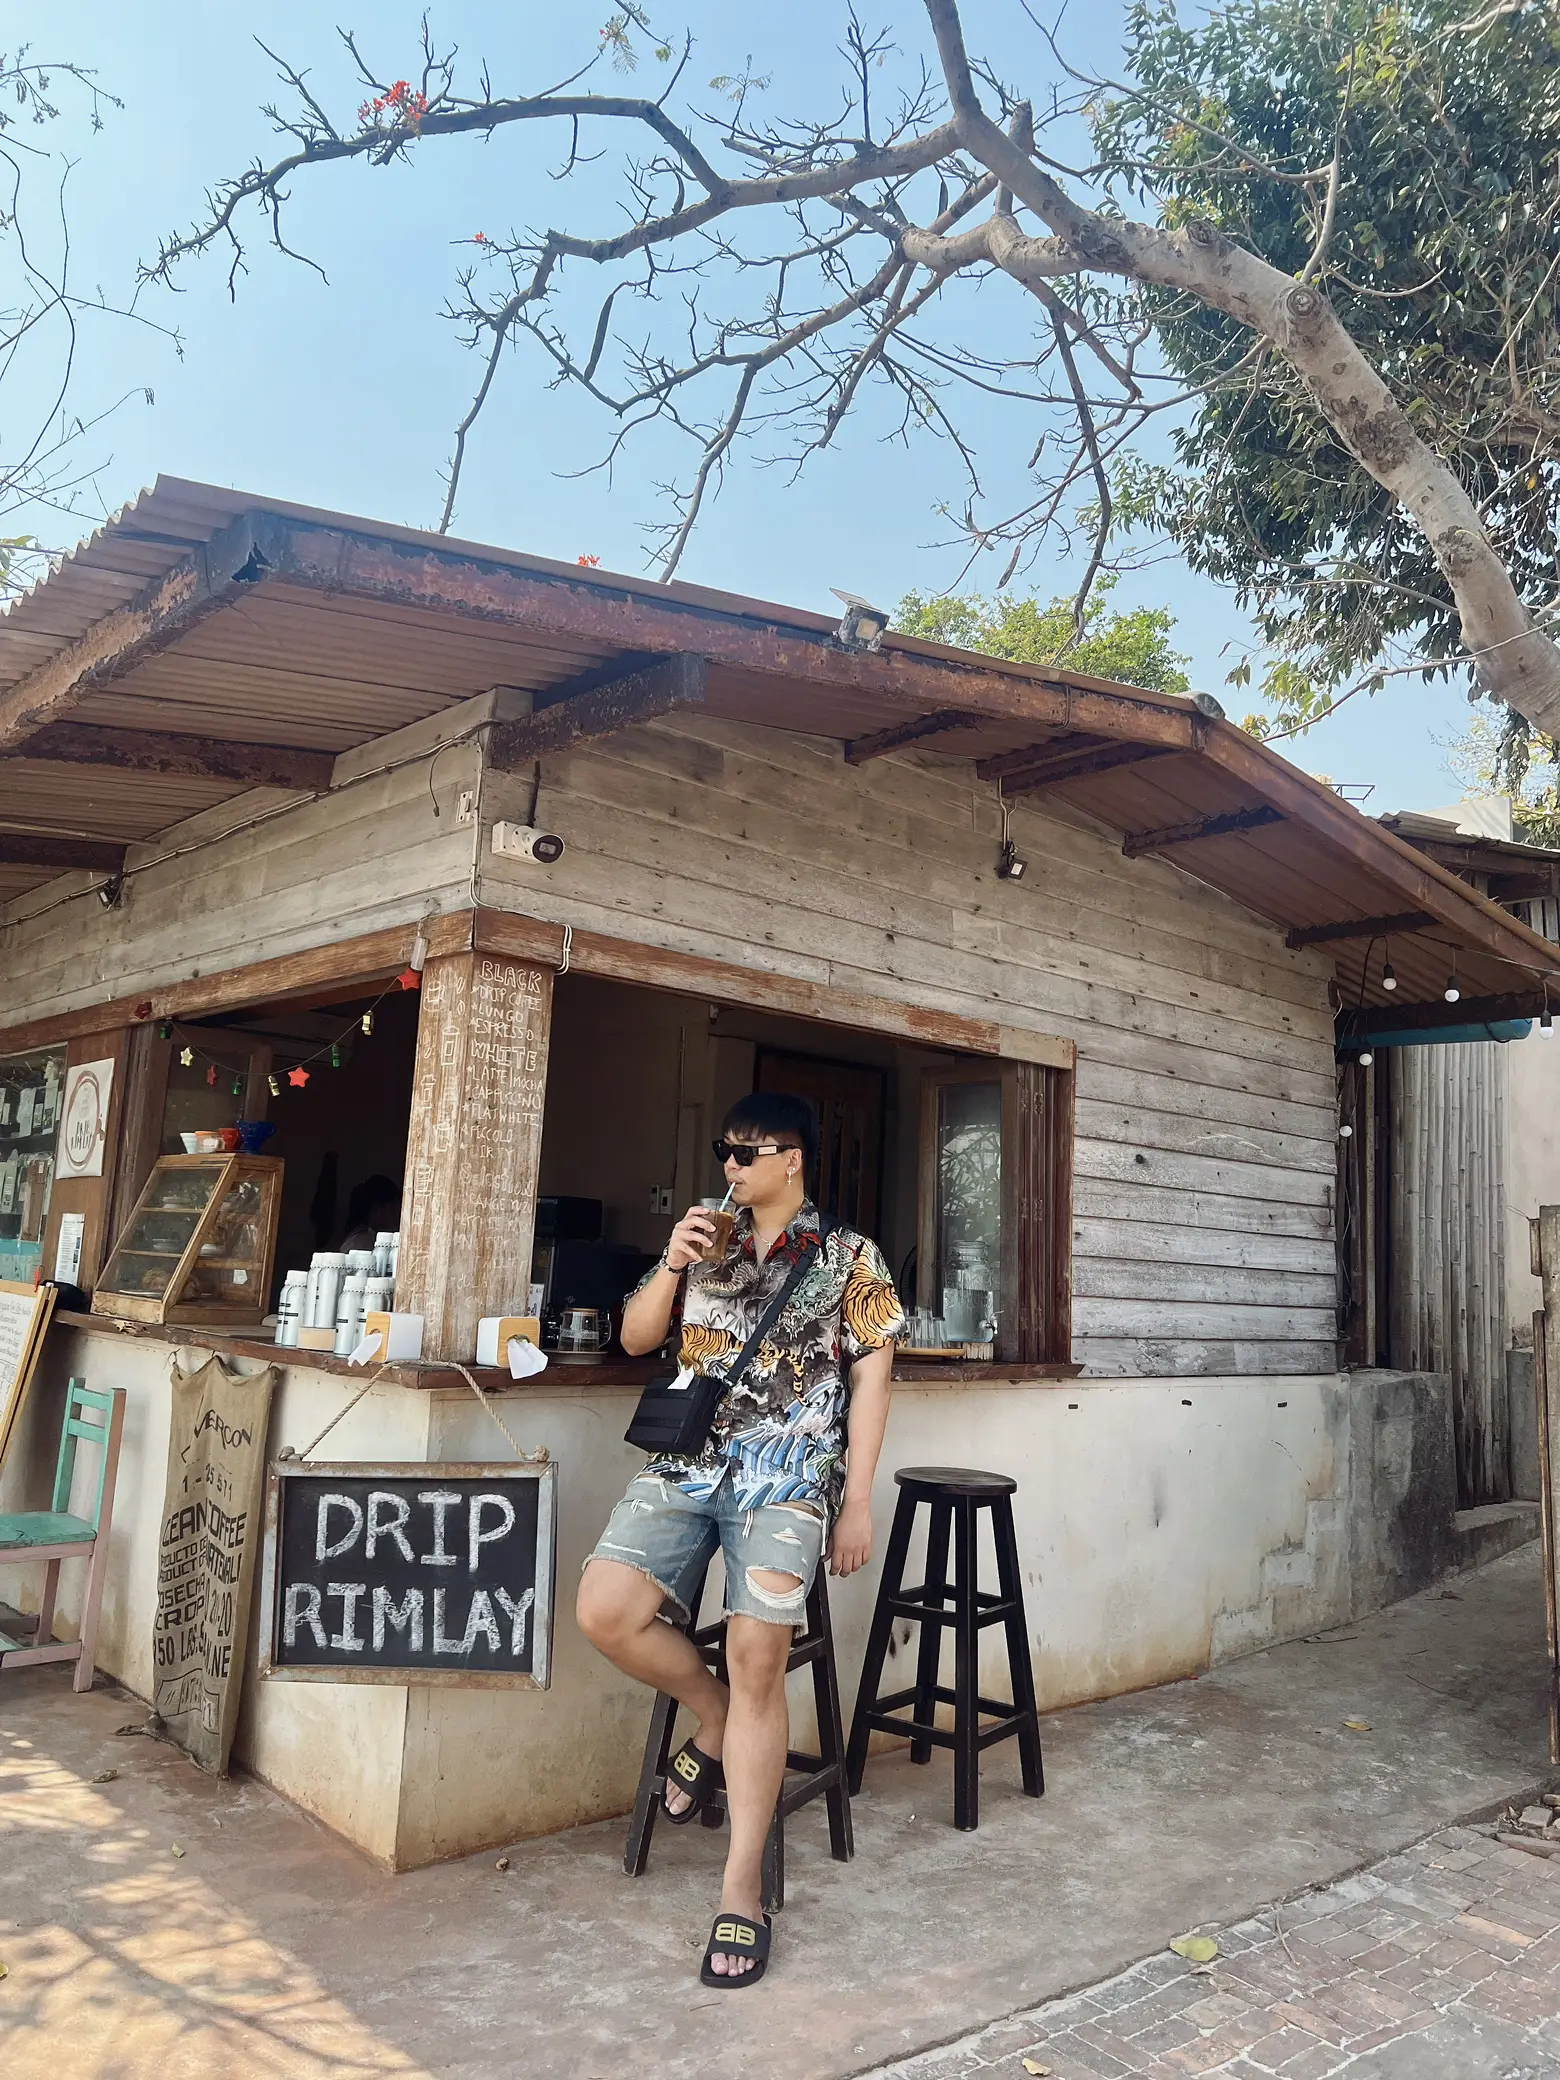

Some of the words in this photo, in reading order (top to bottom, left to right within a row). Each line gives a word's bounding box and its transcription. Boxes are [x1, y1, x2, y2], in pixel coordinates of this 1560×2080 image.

[481, 960, 542, 993] BLACK
[479, 985, 507, 1002] DRIP
[478, 1003, 523, 1022] LUNGO
[475, 1018, 534, 1041] ESPRESSO
[471, 1039, 537, 1071] WHITE
[500, 1110, 540, 1127] WHITE
[315, 1491, 516, 1572] DRIP
[282, 1582, 536, 1657] RIMLAY
